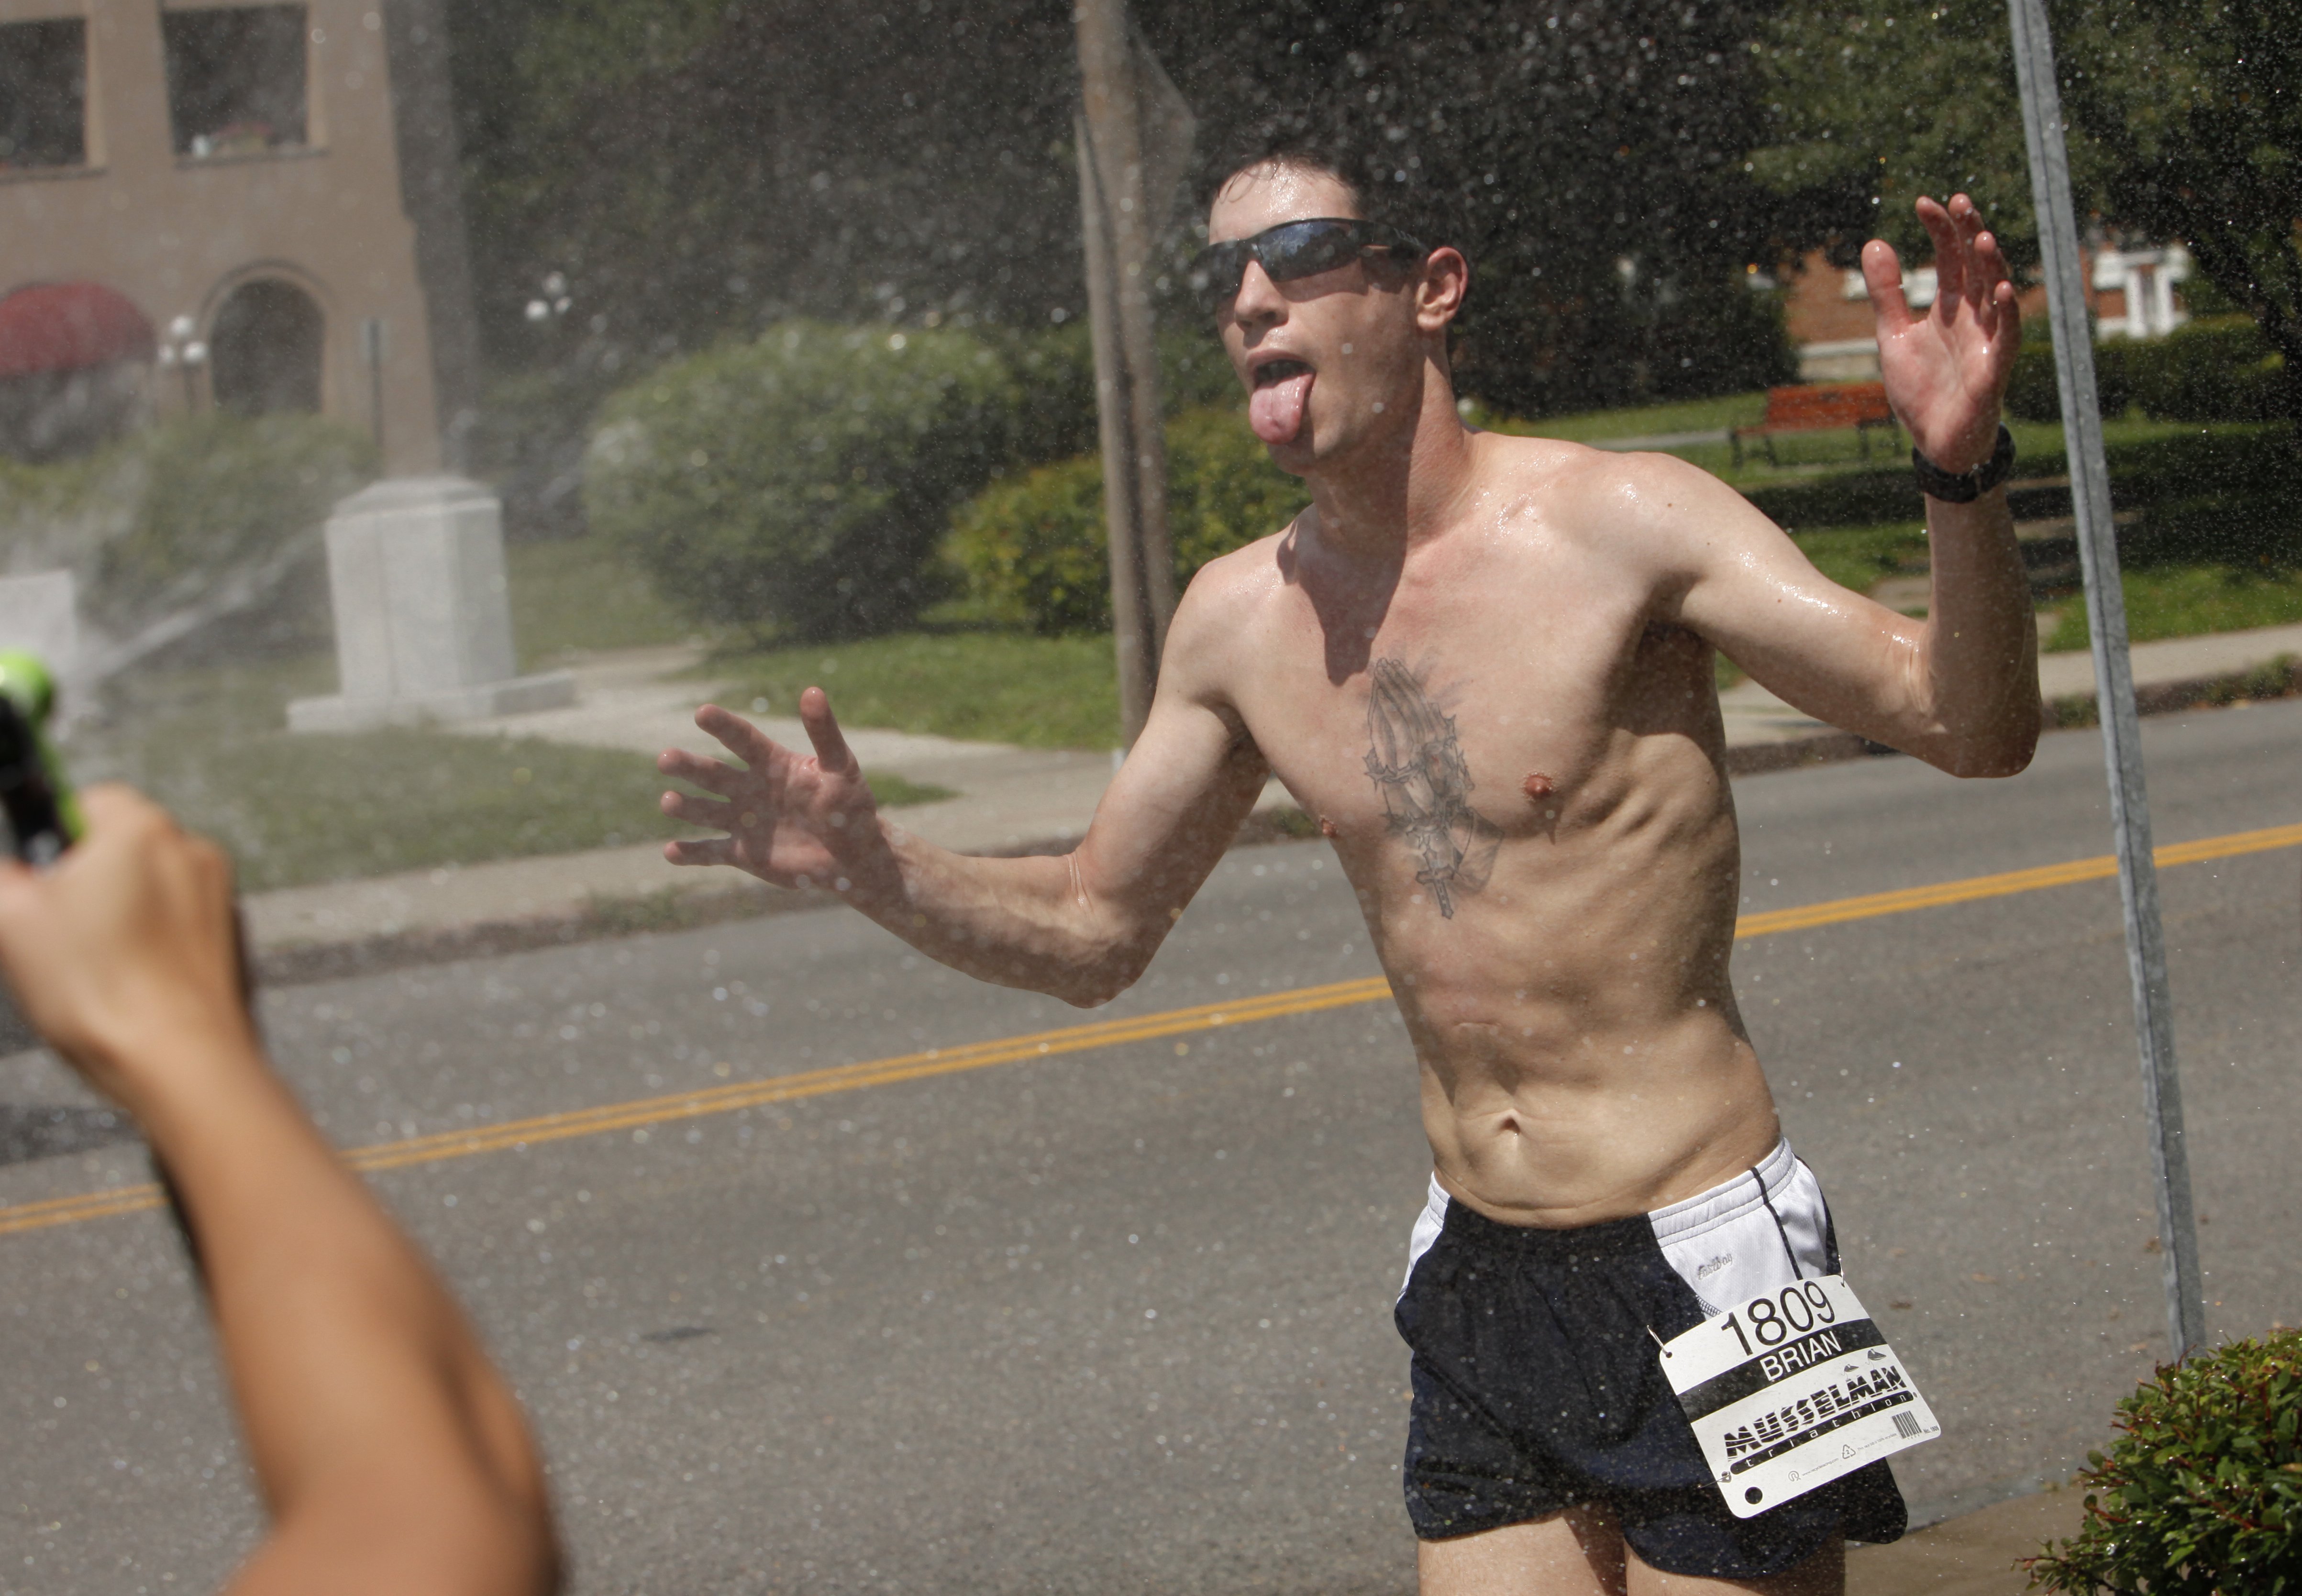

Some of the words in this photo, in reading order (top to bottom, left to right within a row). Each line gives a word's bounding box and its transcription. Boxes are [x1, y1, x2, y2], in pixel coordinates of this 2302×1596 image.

[1721, 1280, 1835, 1356] 1809
[1760, 1330, 1842, 1382] BRIAN
[1723, 1365, 1907, 1462] MUSSELMAN
[1745, 1394, 1907, 1467] triathlon
